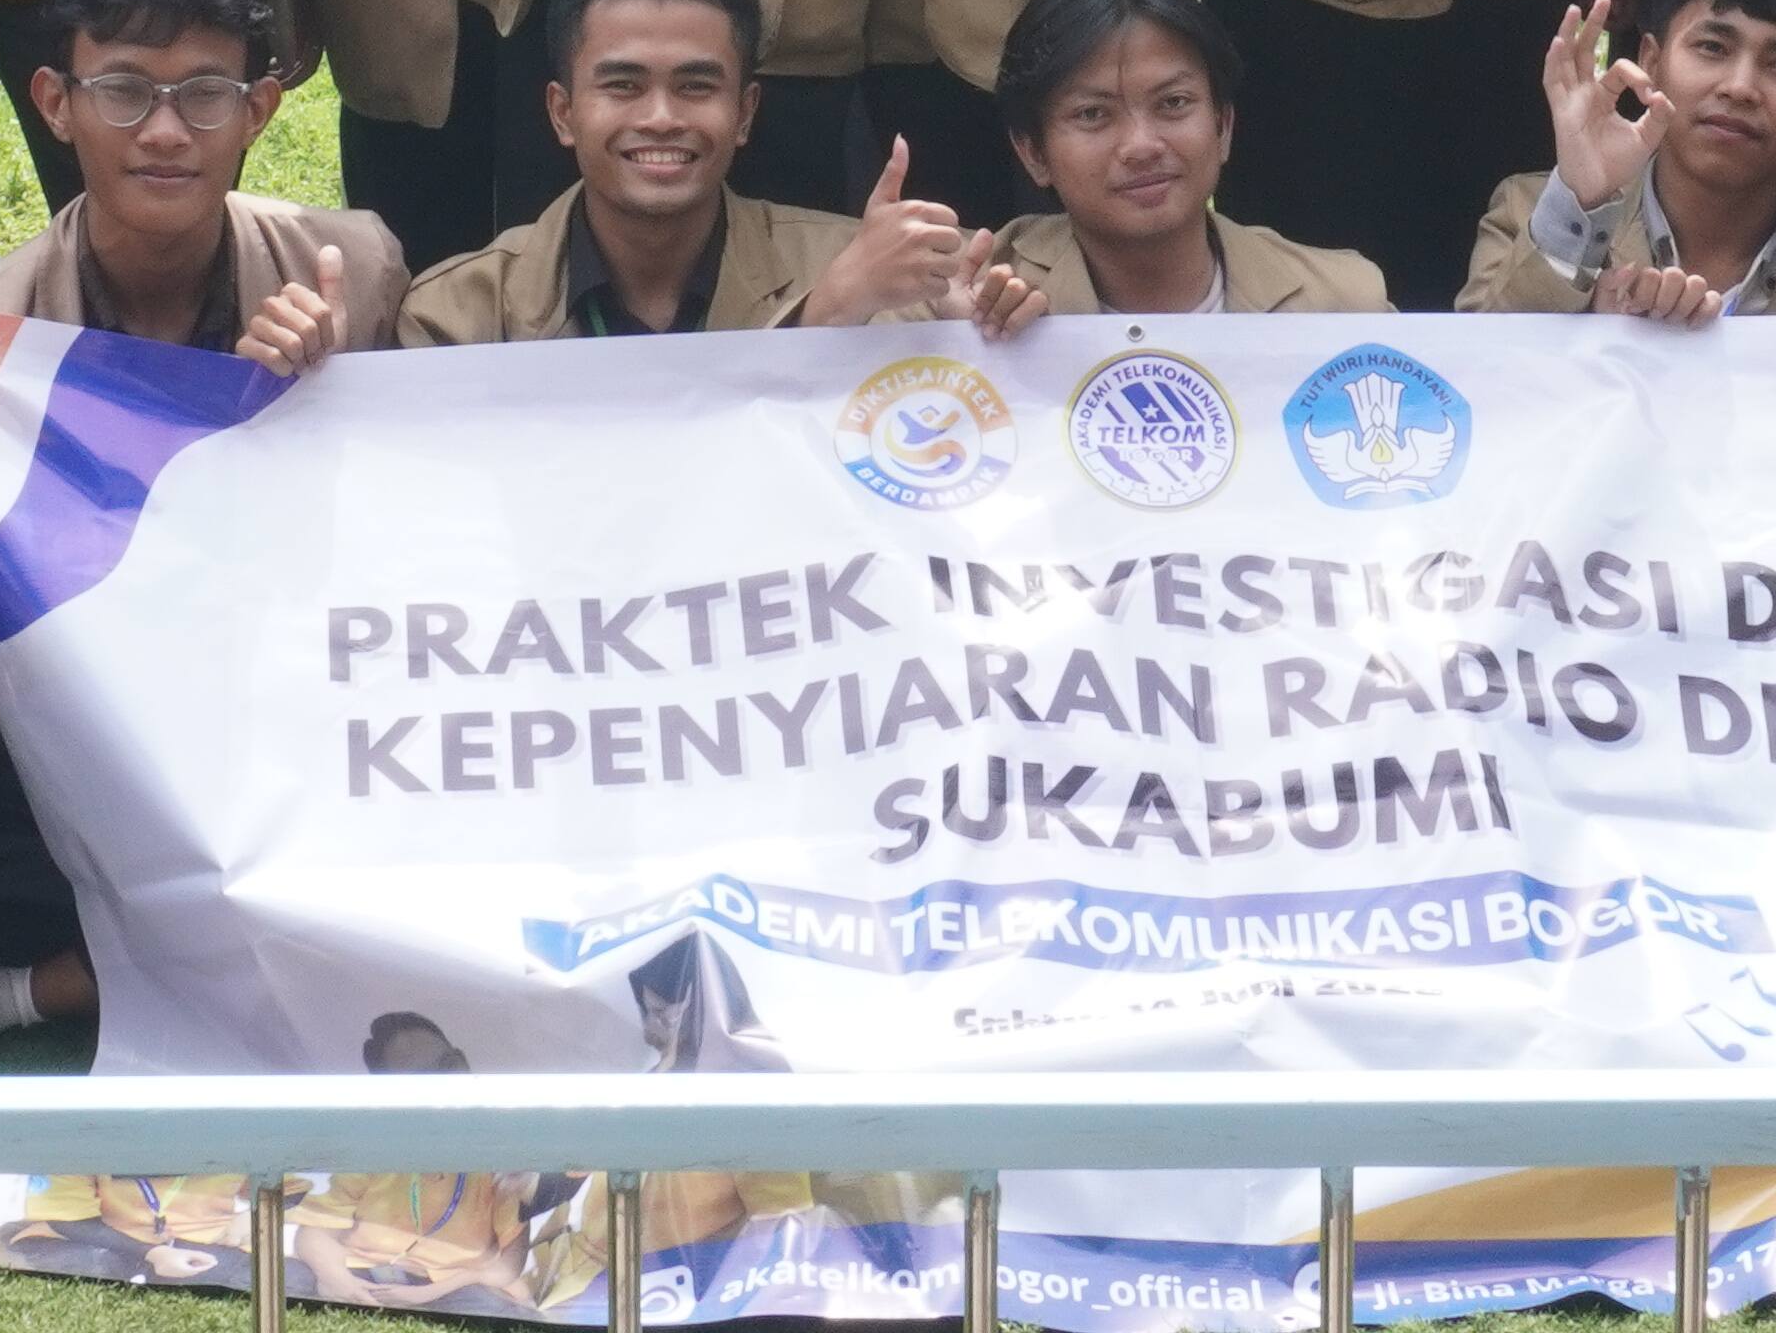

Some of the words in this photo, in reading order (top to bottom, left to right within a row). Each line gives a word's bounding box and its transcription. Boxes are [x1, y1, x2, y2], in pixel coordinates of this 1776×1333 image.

[848, 367, 1000, 423] DIKTISAINTEK
[1077, 379, 1112, 449] AKADEMI
[1113, 364, 1227, 450] TELEKOMUNIKASI
[1300, 380, 1324, 409] TUT
[1322, 354, 1364, 382] WURI
[1368, 353, 1452, 406] HANDAYANI
[1097, 424, 1206, 445] TELKOM
[856, 465, 1000, 507] BERDAMPAK
[327, 551, 892, 682] PRAKTEK
[929, 540, 1681, 634] INVESTIGASI
[347, 642, 1217, 797] KEPENYIARAN
[1262, 640, 1638, 743] RADIO
[870, 747, 1513, 865] SUKABUMI
[576, 880, 875, 957] AKADEMI
[890, 894, 1473, 963] TELEKOMUNIKASI
[1484, 885, 1729, 947] BOGOR
[719, 1259, 1265, 1312] akatelkomogor_official
[1373, 1281, 1412, 1311] Jl.
[1424, 1279, 1515, 1304] Bina
